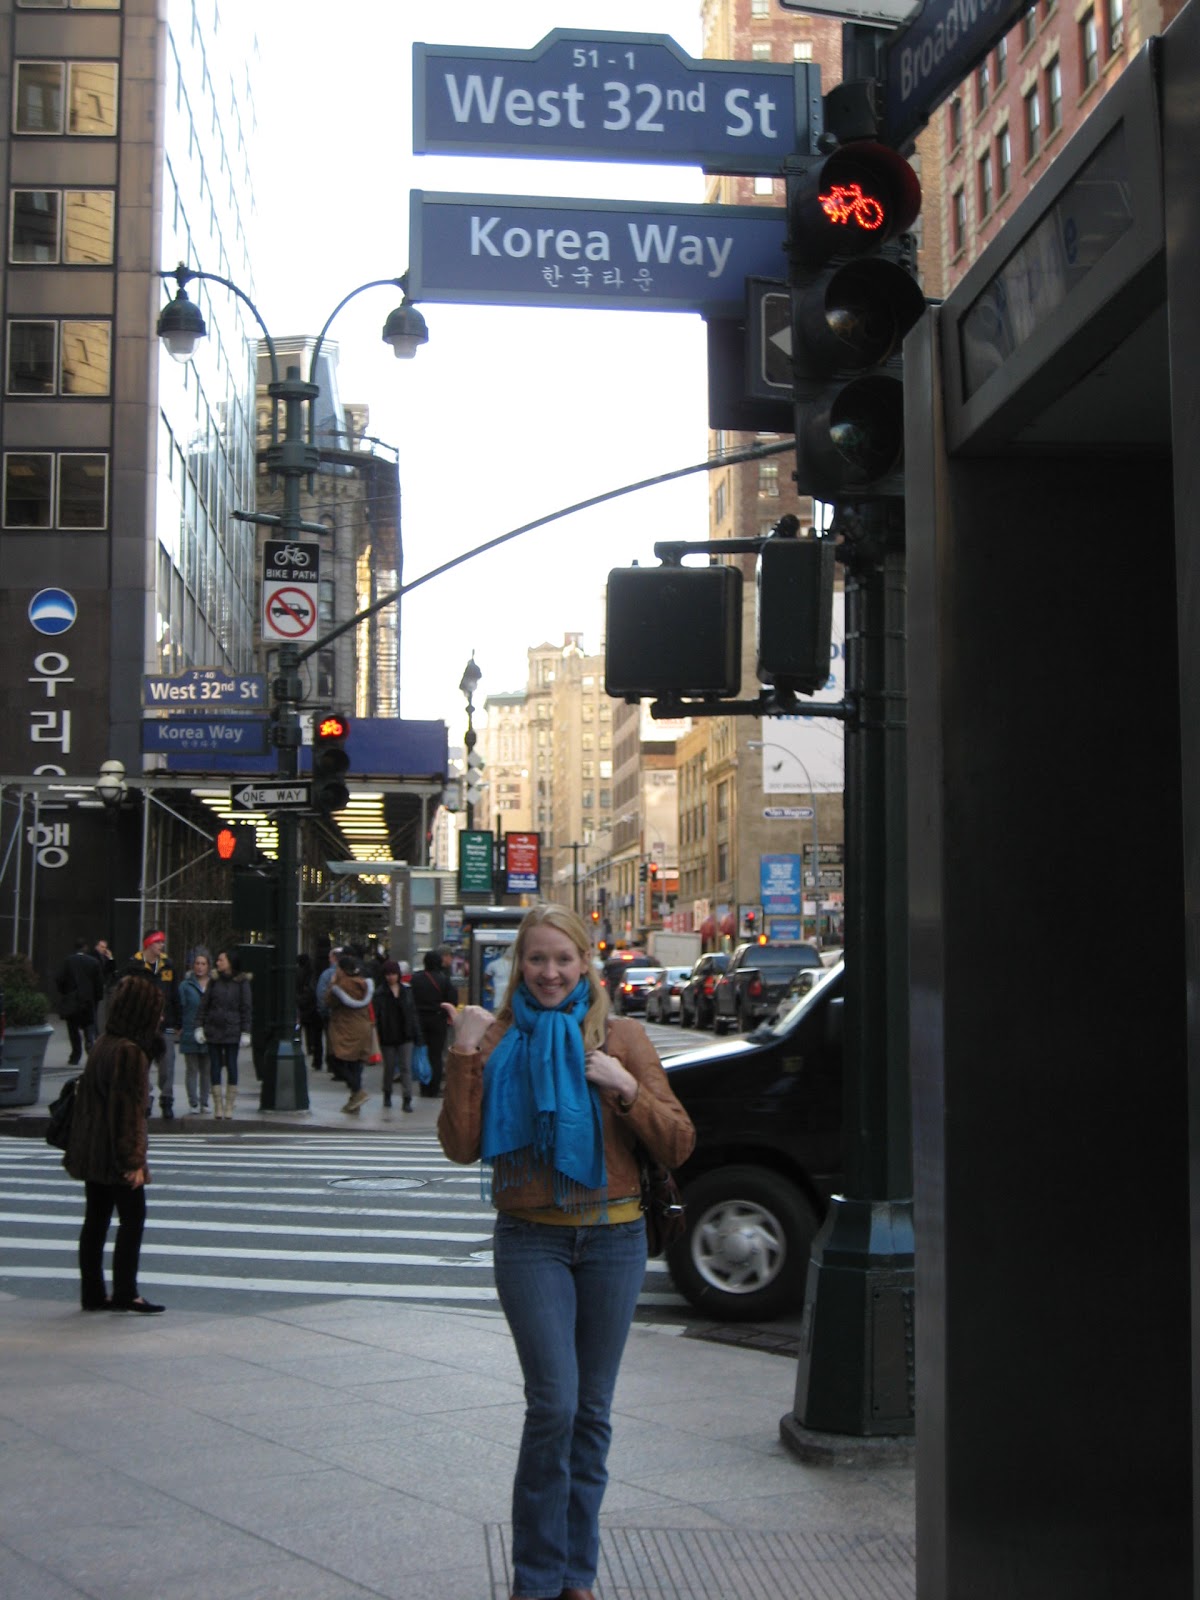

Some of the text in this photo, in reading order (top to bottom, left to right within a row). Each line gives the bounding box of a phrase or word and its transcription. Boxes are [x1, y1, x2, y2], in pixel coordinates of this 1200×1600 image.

[573, 48, 599, 69] 51
[624, 51, 635, 70] 1
[900, 0, 1002, 103] Broadw
[444, 73, 778, 139] West 32nd St
[470, 216, 734, 278] Korea Way
[266, 569, 317, 580] BIKE PATH
[192, 671, 199, 680] 2
[204, 671, 216, 680] 40
[150, 680, 259, 700] West 32nd St
[158, 724, 244, 743] Korea Way
[242, 789, 302, 802] ONE WAY
